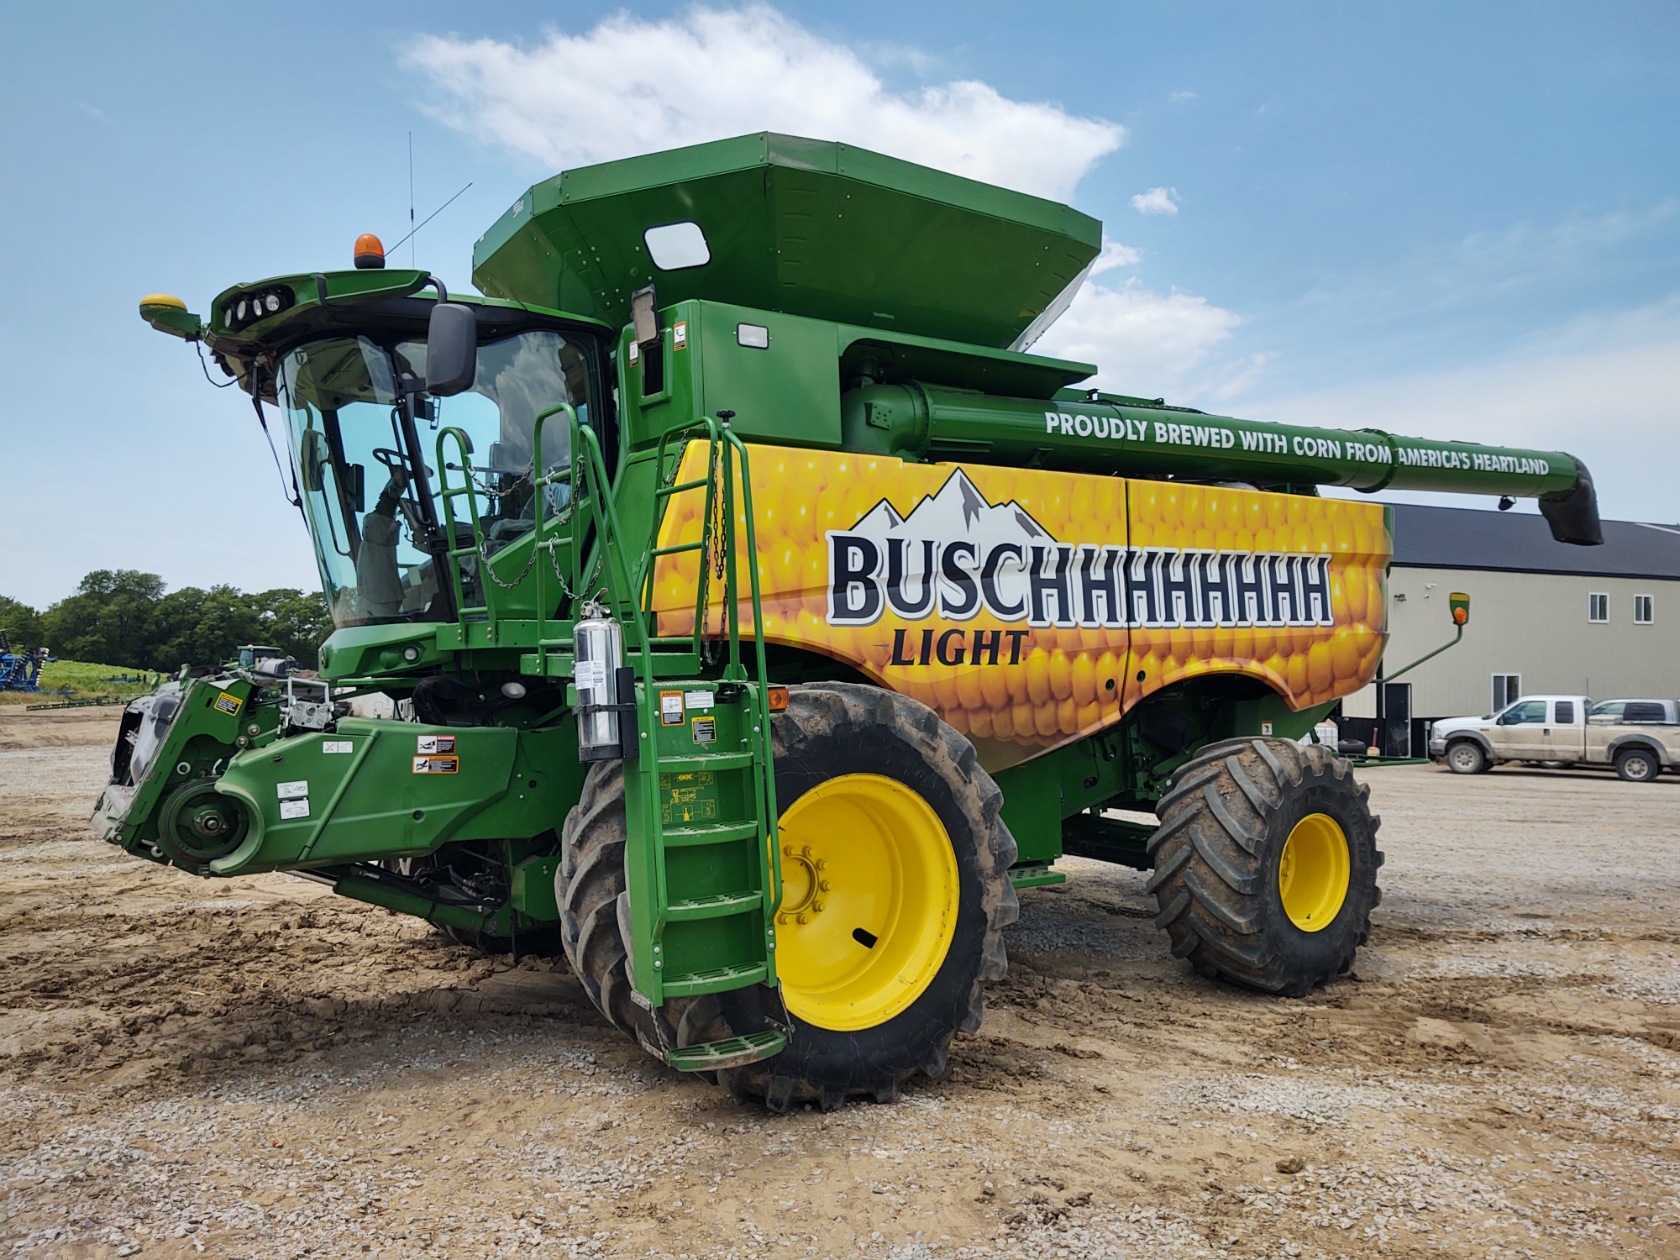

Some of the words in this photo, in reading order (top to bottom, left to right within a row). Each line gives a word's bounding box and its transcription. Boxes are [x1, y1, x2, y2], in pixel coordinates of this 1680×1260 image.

[1045, 412, 1148, 441] PROUDLY
[1154, 422, 1235, 449] BREWED
[1239, 430, 1288, 454] WITH
[1293, 437, 1341, 458] CORN
[1346, 442, 1392, 464] FROM
[1398, 447, 1470, 469] AMERICA'S
[1474, 454, 1549, 475] HEARTLAND
[891, 629, 1030, 666] LIGHT
